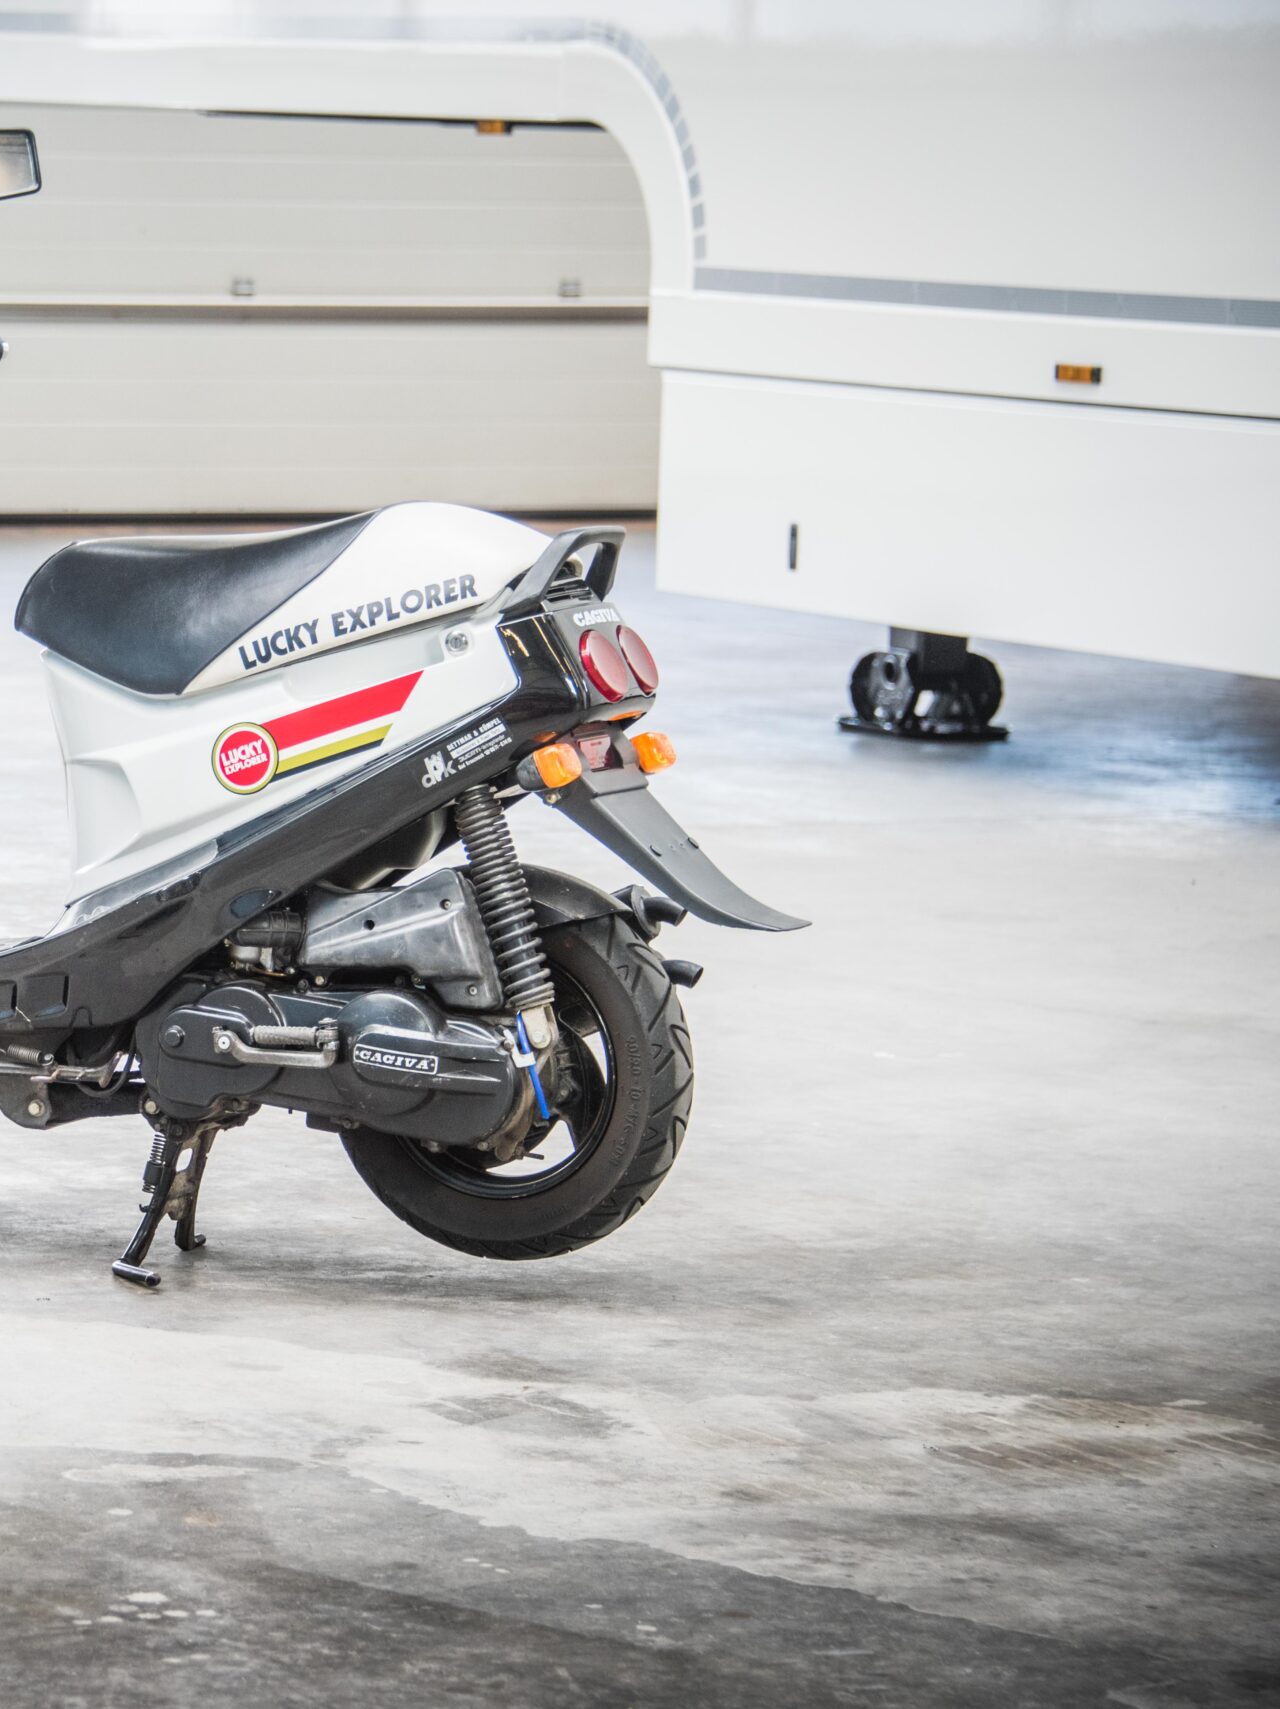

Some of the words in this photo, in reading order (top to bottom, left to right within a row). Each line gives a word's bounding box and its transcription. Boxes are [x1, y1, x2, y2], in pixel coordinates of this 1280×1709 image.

[238, 618, 319, 670] LUCKY
[331, 574, 478, 637] EXPLORER
[572, 608, 620, 627] CAGIVA
[221, 739, 263, 767] LUCKY
[224, 753, 268, 776] EXPLORER
[359, 1051, 430, 1070] CAGIVA
